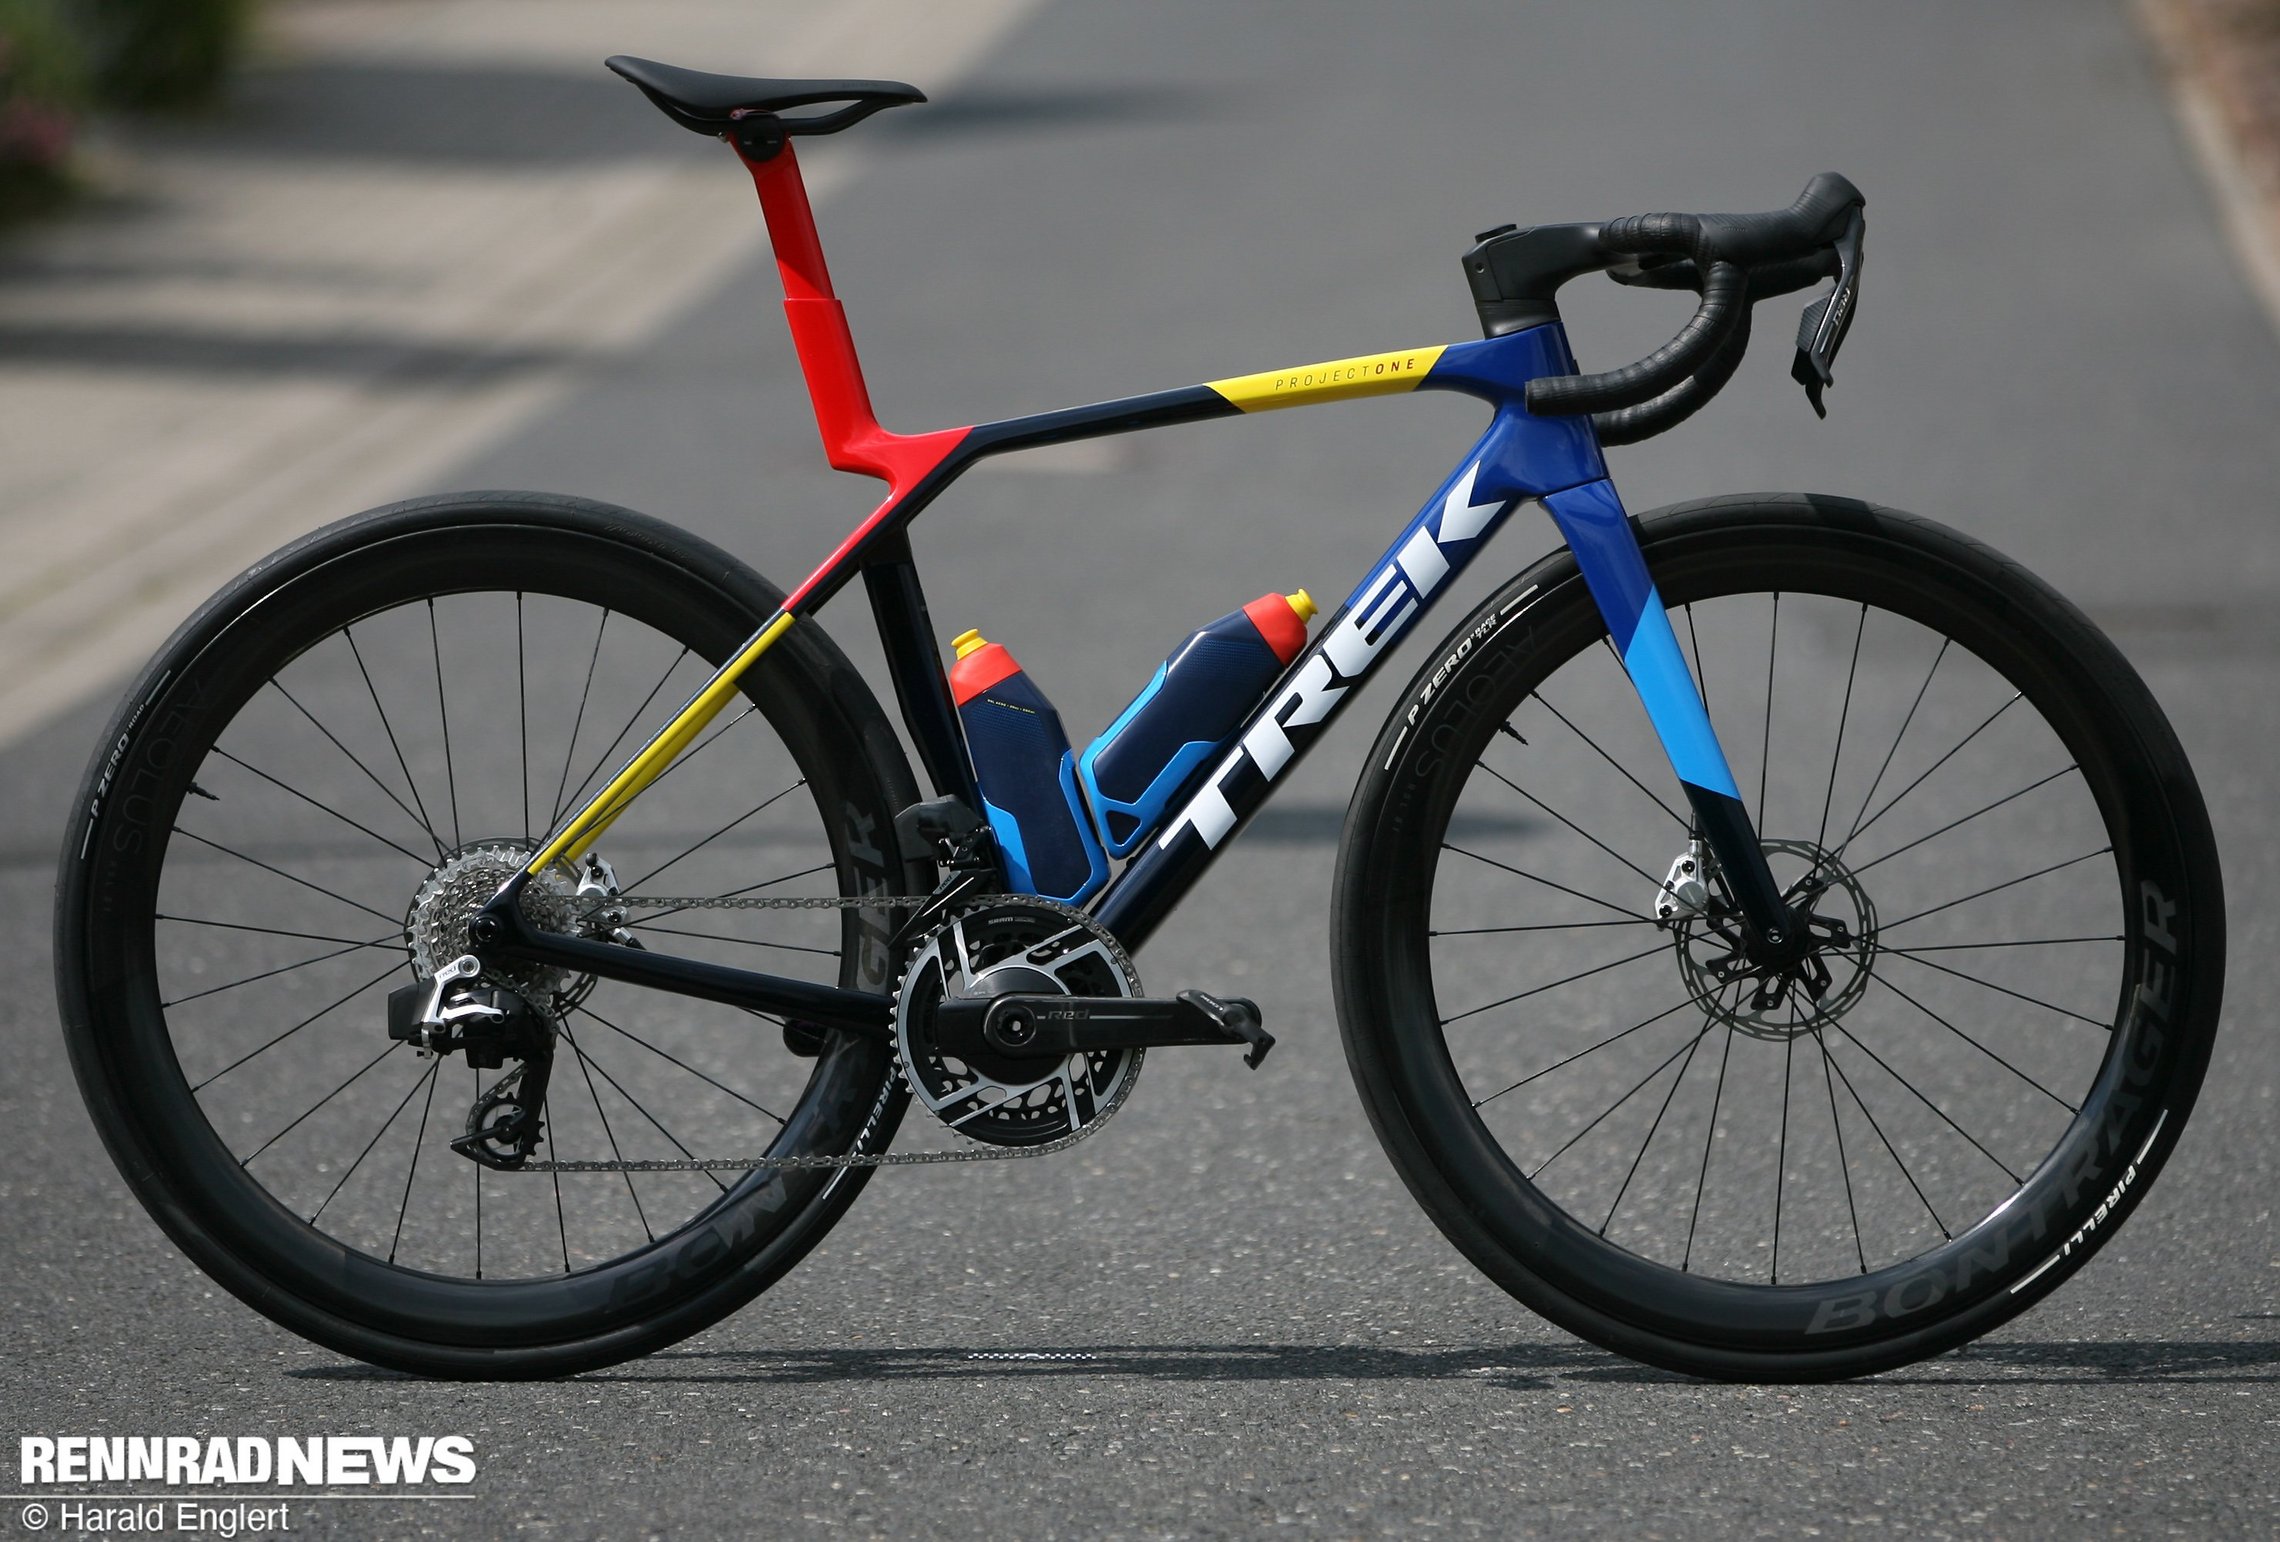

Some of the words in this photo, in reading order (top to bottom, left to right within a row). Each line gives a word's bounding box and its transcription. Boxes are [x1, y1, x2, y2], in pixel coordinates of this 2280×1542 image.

[1157, 460, 1506, 851] TREK
[1415, 626, 1537, 778] AEOLUS
[1420, 637, 1473, 706] ZERO
[97, 732, 131, 798] ZERO
[857, 1066, 897, 1151] PIRELLI
[1805, 879, 2178, 1335] BONTRAGER
[2063, 1163, 2138, 1256] PIRELLI
